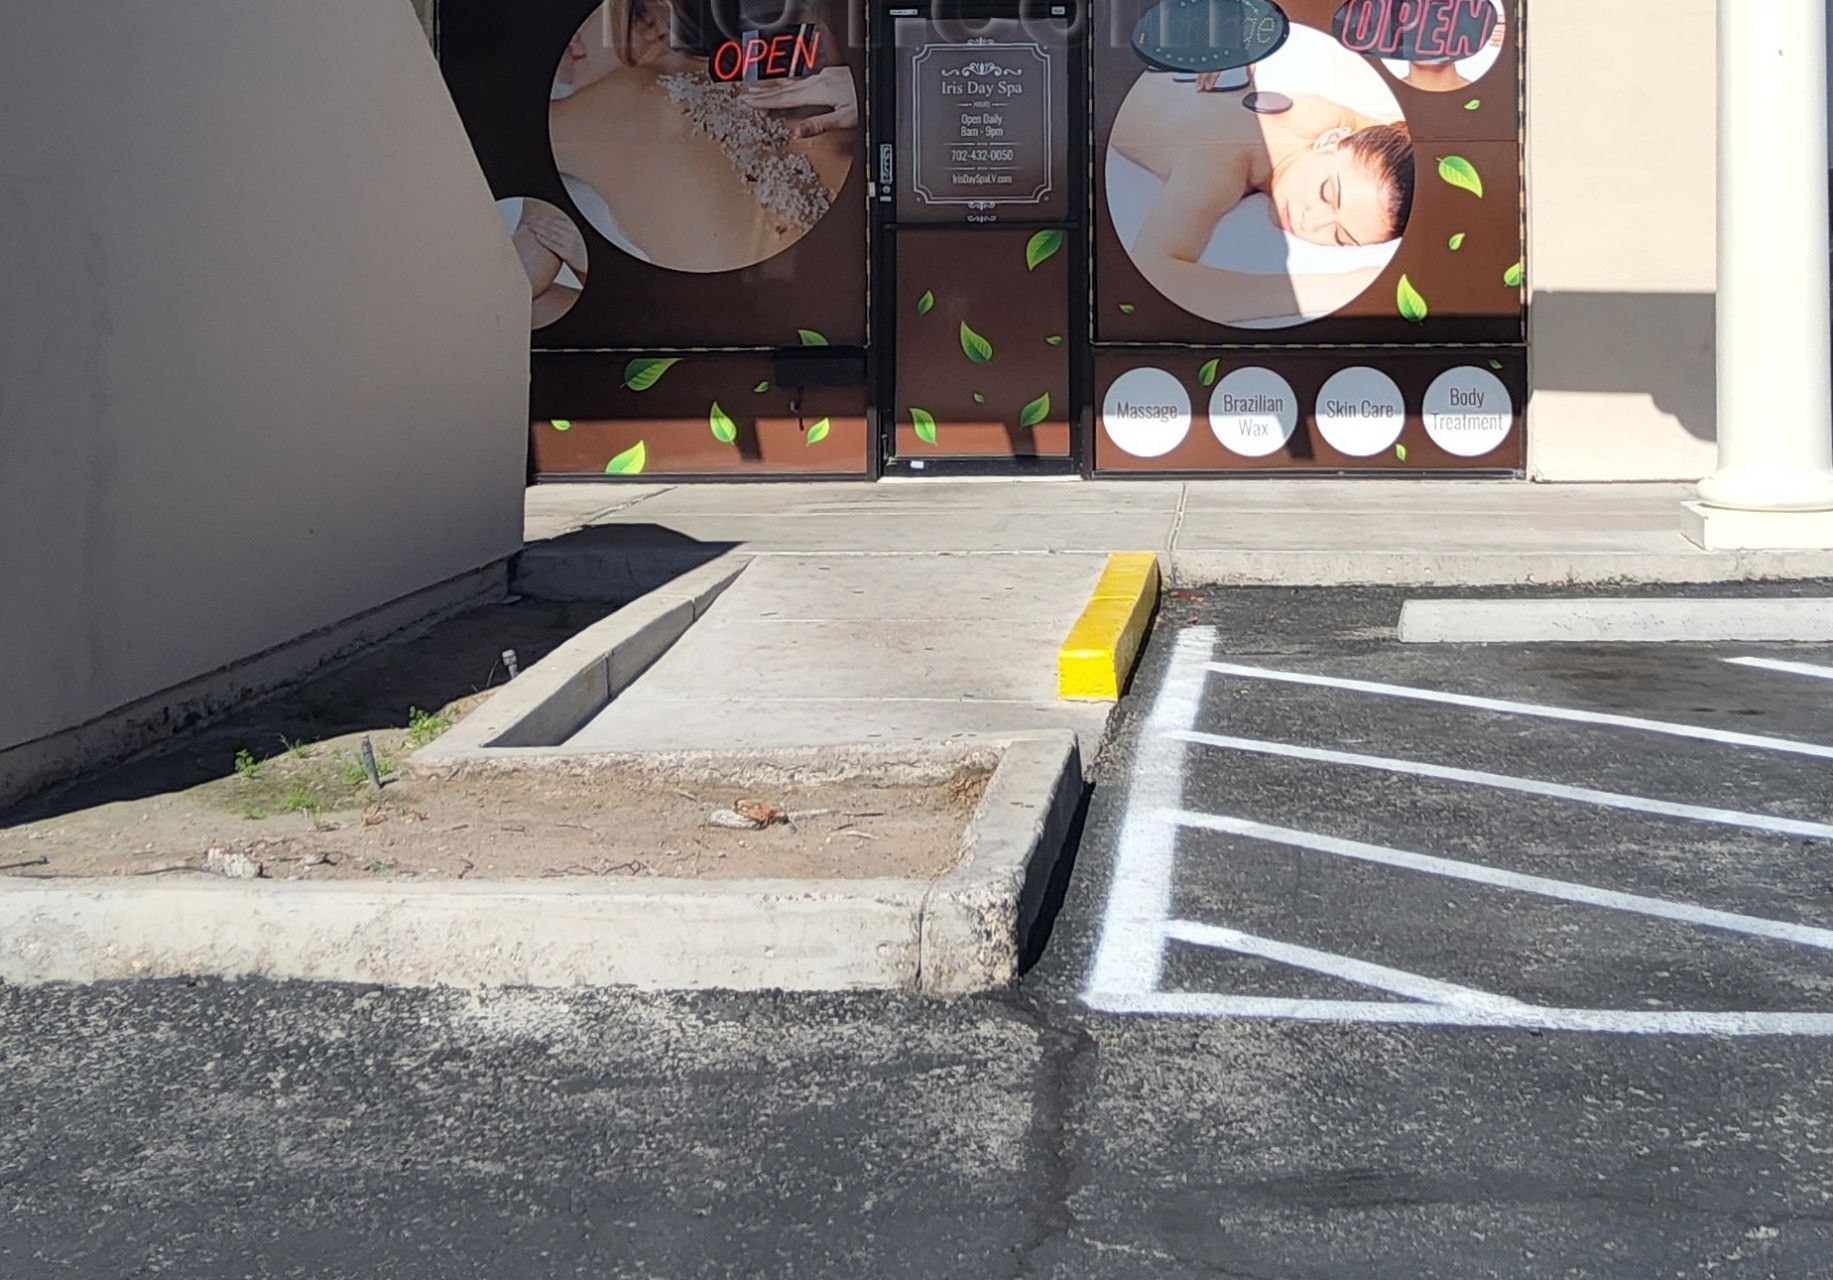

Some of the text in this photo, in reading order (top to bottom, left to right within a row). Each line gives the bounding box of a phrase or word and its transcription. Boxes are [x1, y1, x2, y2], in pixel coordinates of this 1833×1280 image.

[714, 32, 821, 80] OPEN
[942, 81, 1023, 97] Iris Day Spa
[961, 113, 1003, 126] Open Daily
[961, 126, 979, 137] 8am
[985, 126, 1004, 138] 9pm
[951, 149, 1014, 161] 702-432-0050
[1223, 393, 1284, 413] Brazilian
[1450, 387, 1485, 408] Body
[1116, 401, 1178, 423] Massage
[1326, 400, 1394, 418] Skin Care
[1238, 417, 1269, 437] Wax
[1431, 412, 1504, 431] Treatment
